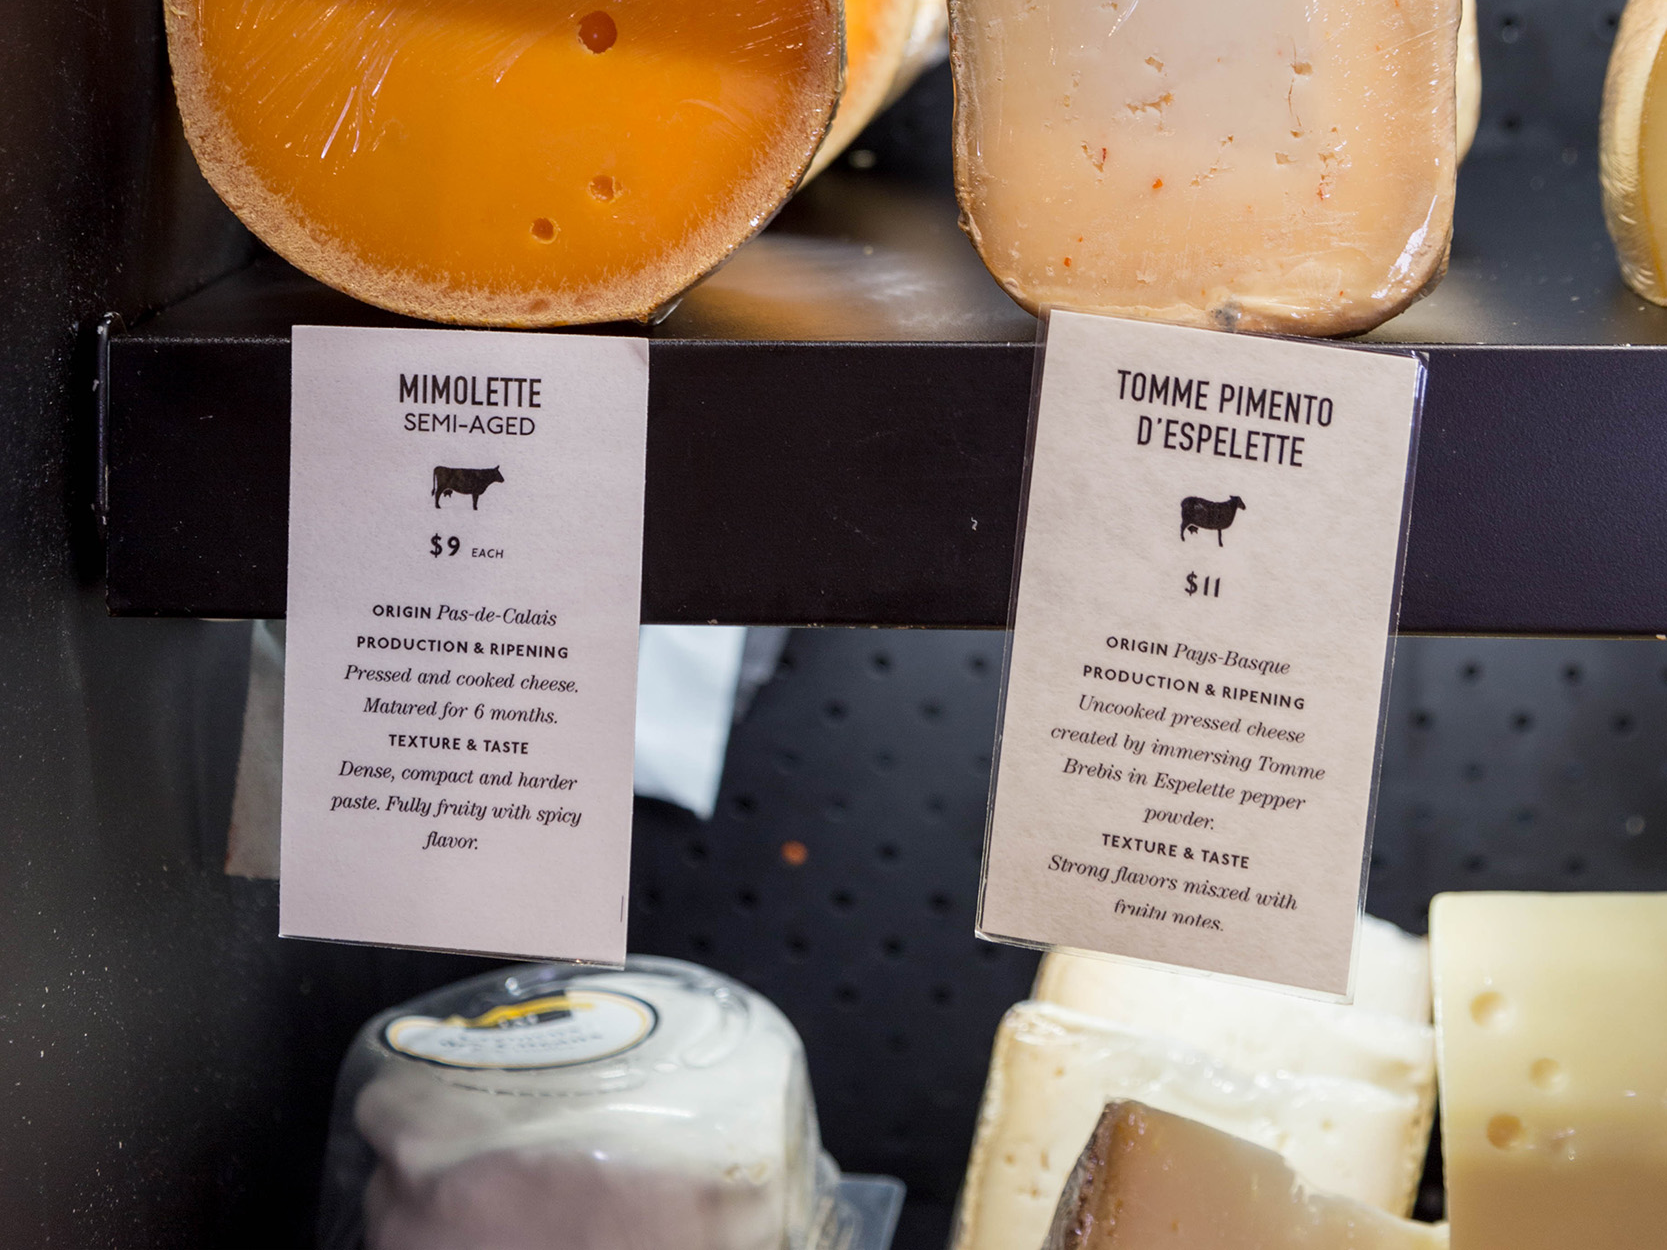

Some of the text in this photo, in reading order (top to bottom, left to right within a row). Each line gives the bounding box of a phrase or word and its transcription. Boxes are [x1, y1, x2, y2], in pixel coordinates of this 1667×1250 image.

[400, 374, 541, 408] MIMOLETTE
[1118, 369, 1334, 428] TOMME PIMENTO
[404, 413, 535, 435] SEMI-AGED
[430, 533, 504, 558] $9 EACH
[1185, 571, 1220, 597] $11
[372, 605, 557, 626] ORIGIN Pas-de-Calais
[357, 636, 568, 659] PRODUCTION & RIPENING
[1106, 636, 1290, 675] ORIGIN Pays-Basque
[344, 665, 578, 693] Pressed and cooked cheese.
[1083, 665, 1304, 710] PRODUCTION & RIPENING
[363, 697, 557, 724] Matured for 6 months.
[1079, 694, 1305, 743] Uncooked pressed cheese
[389, 734, 528, 754] TEXTURE & TASTE
[1051, 728, 1325, 780] created by immersing Tomme
[339, 761, 577, 790] Dense, compact and harder
[1062, 758, 1122, 781] Brebis
[1154, 772, 1235, 798] Espelette
[1239, 790, 1306, 810] pepper
[330, 796, 582, 827] paste. Fully fruity with spicy
[1142, 808, 1214, 830] powder.
[422, 831, 477, 850] flavor.
[1102, 833, 1249, 869] TEXTURE & TASTE
[1048, 855, 1110, 882] Strong
[1111, 866, 1178, 890] flavors
[1256, 892, 1297, 910] with
[1172, 912, 1223, 931] notes.
